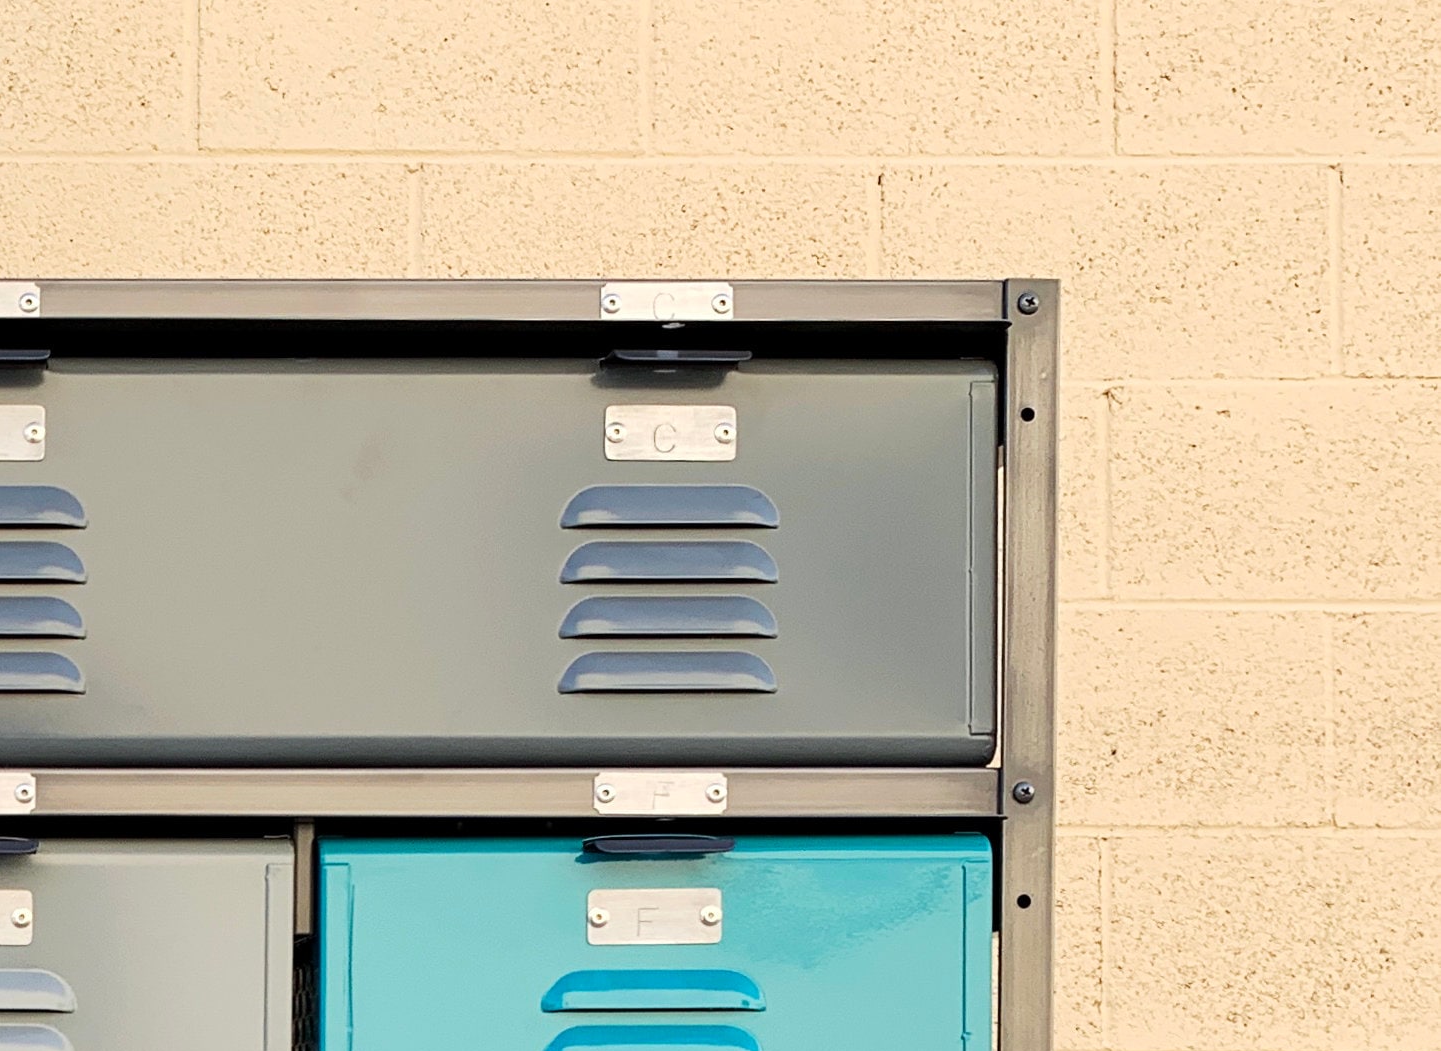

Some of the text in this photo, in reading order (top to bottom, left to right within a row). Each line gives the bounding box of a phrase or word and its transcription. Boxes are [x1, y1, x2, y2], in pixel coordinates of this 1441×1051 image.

[652, 292, 676, 320] C
[654, 423, 677, 454] C
[652, 780, 676, 811] F
[637, 907, 660, 937] F
